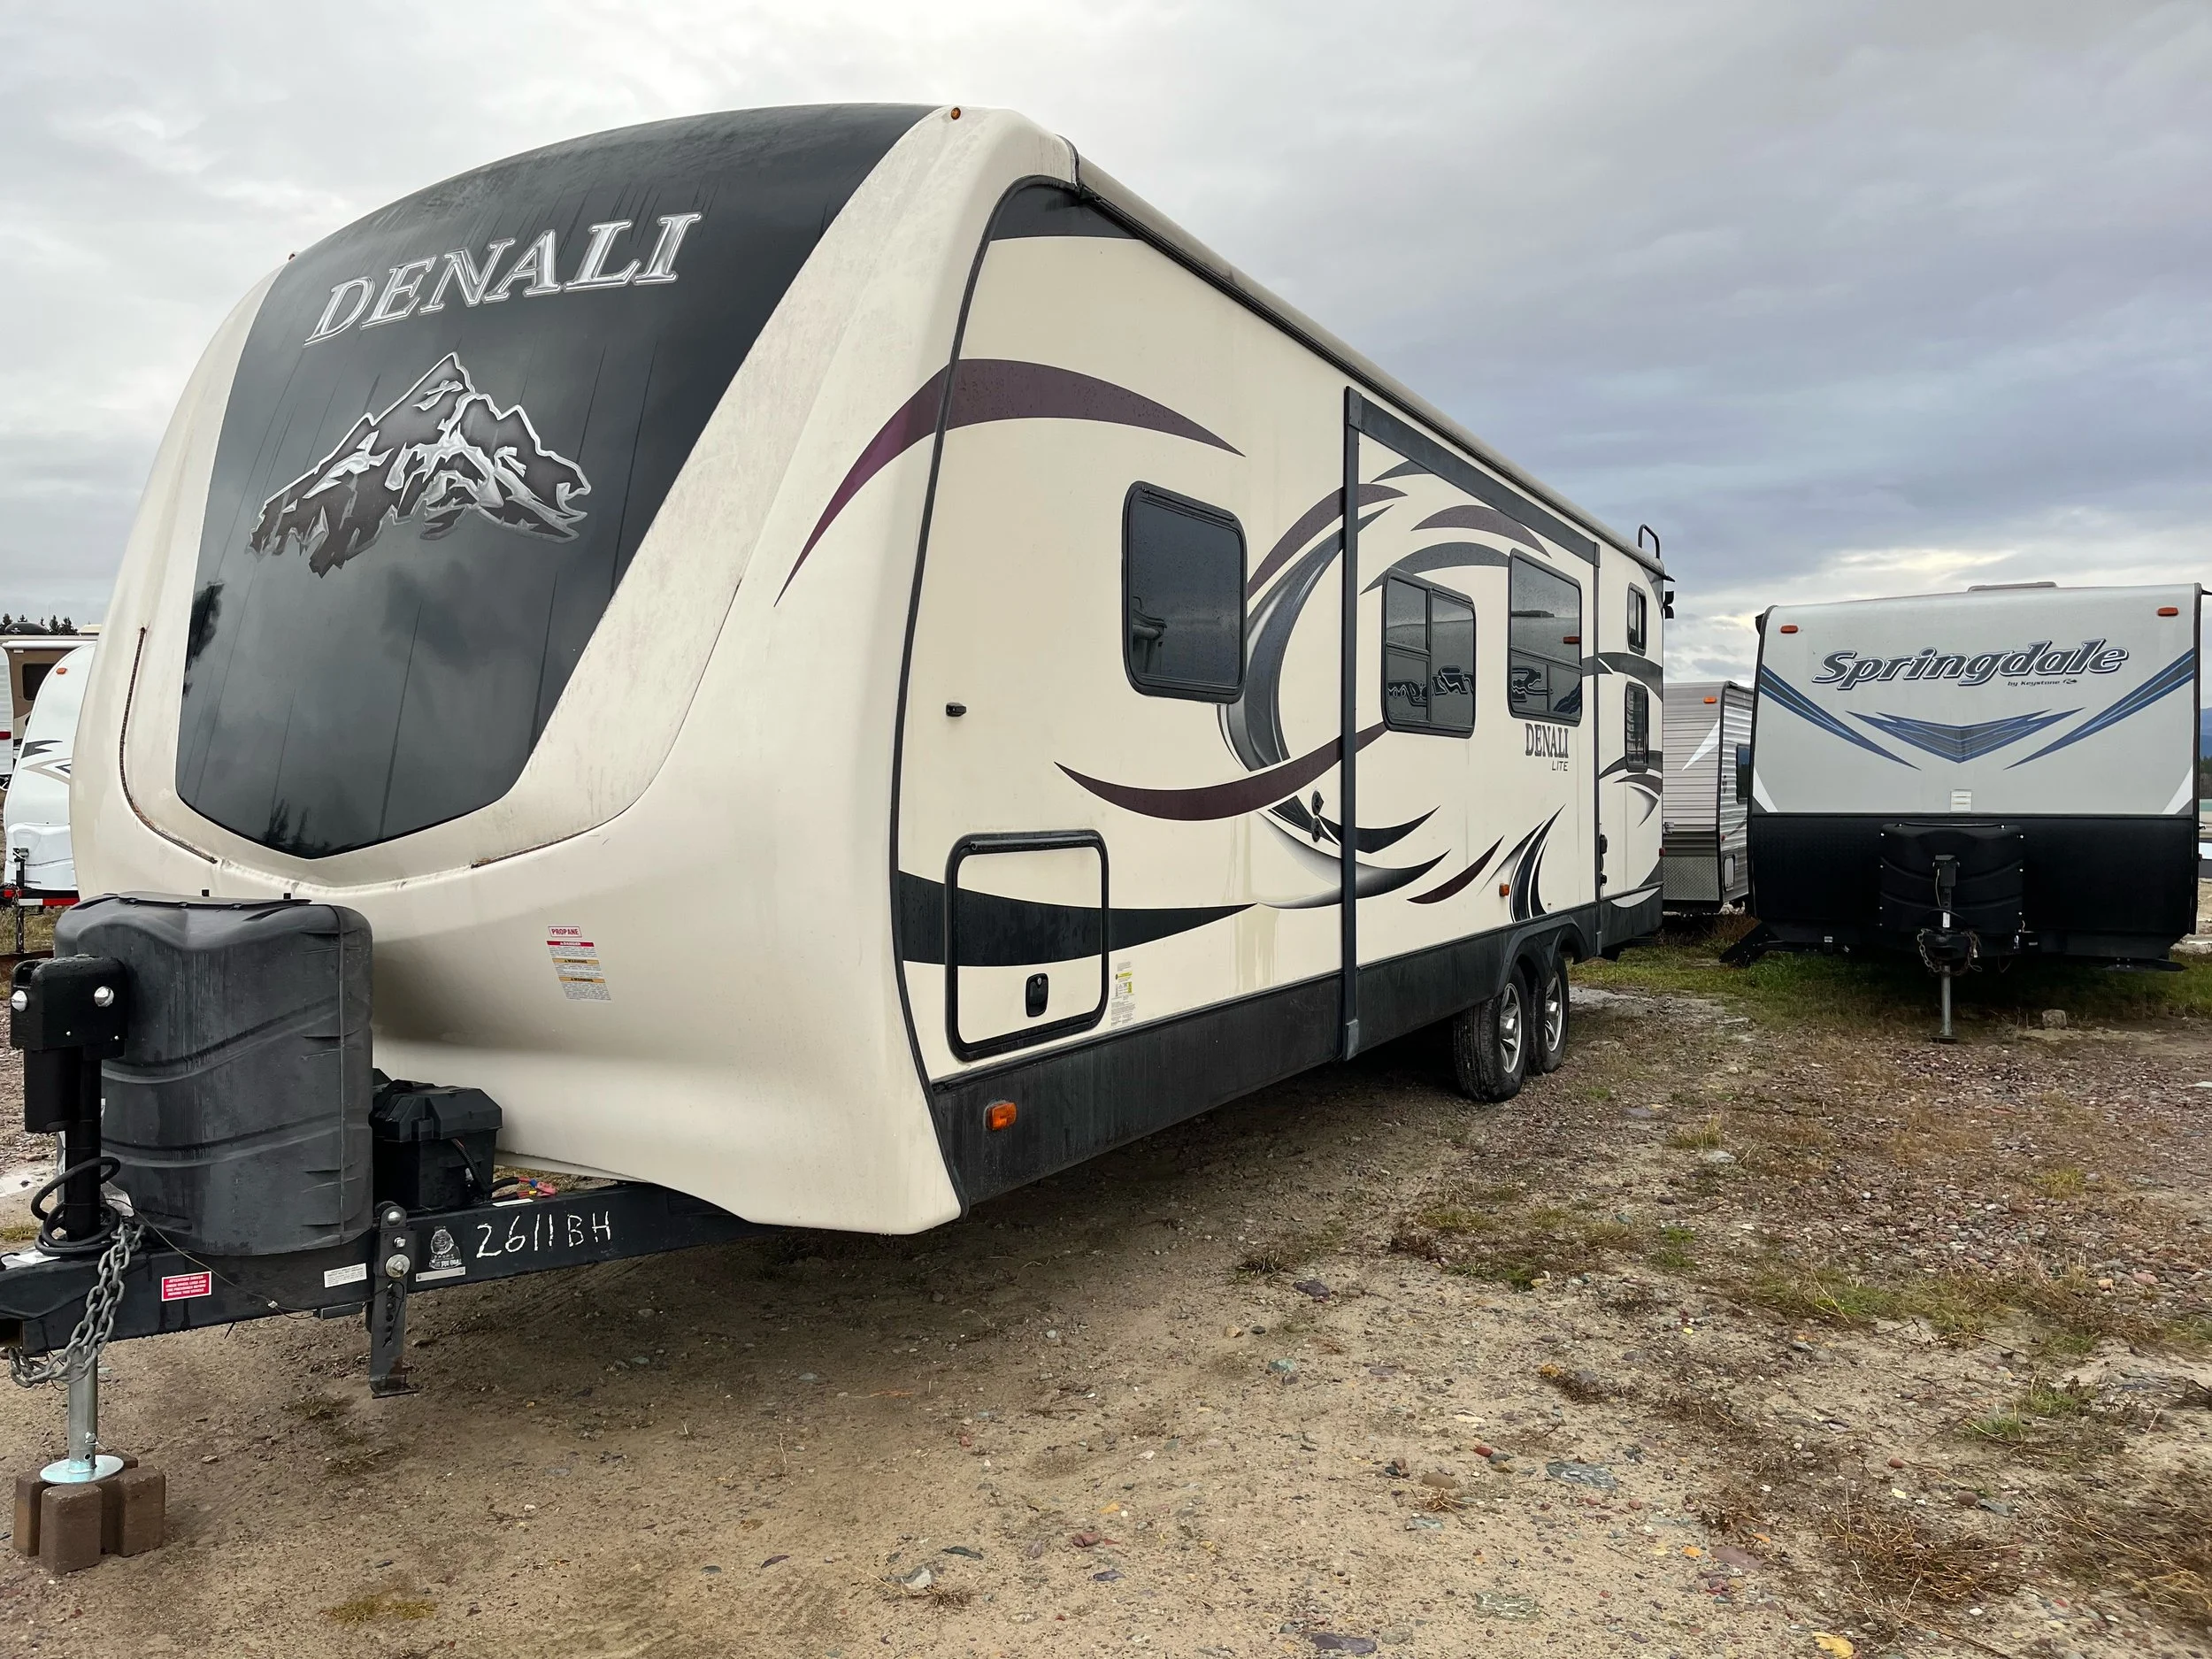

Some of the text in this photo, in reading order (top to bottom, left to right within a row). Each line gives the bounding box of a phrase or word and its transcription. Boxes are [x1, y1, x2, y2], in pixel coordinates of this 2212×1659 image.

[303, 211, 703, 348] DENALI
[1812, 638, 2129, 690] Springdale
[1525, 723, 1569, 758] DENALI
[1552, 761, 1569, 772] LITE
[476, 1211, 611, 1258] 2611BH
